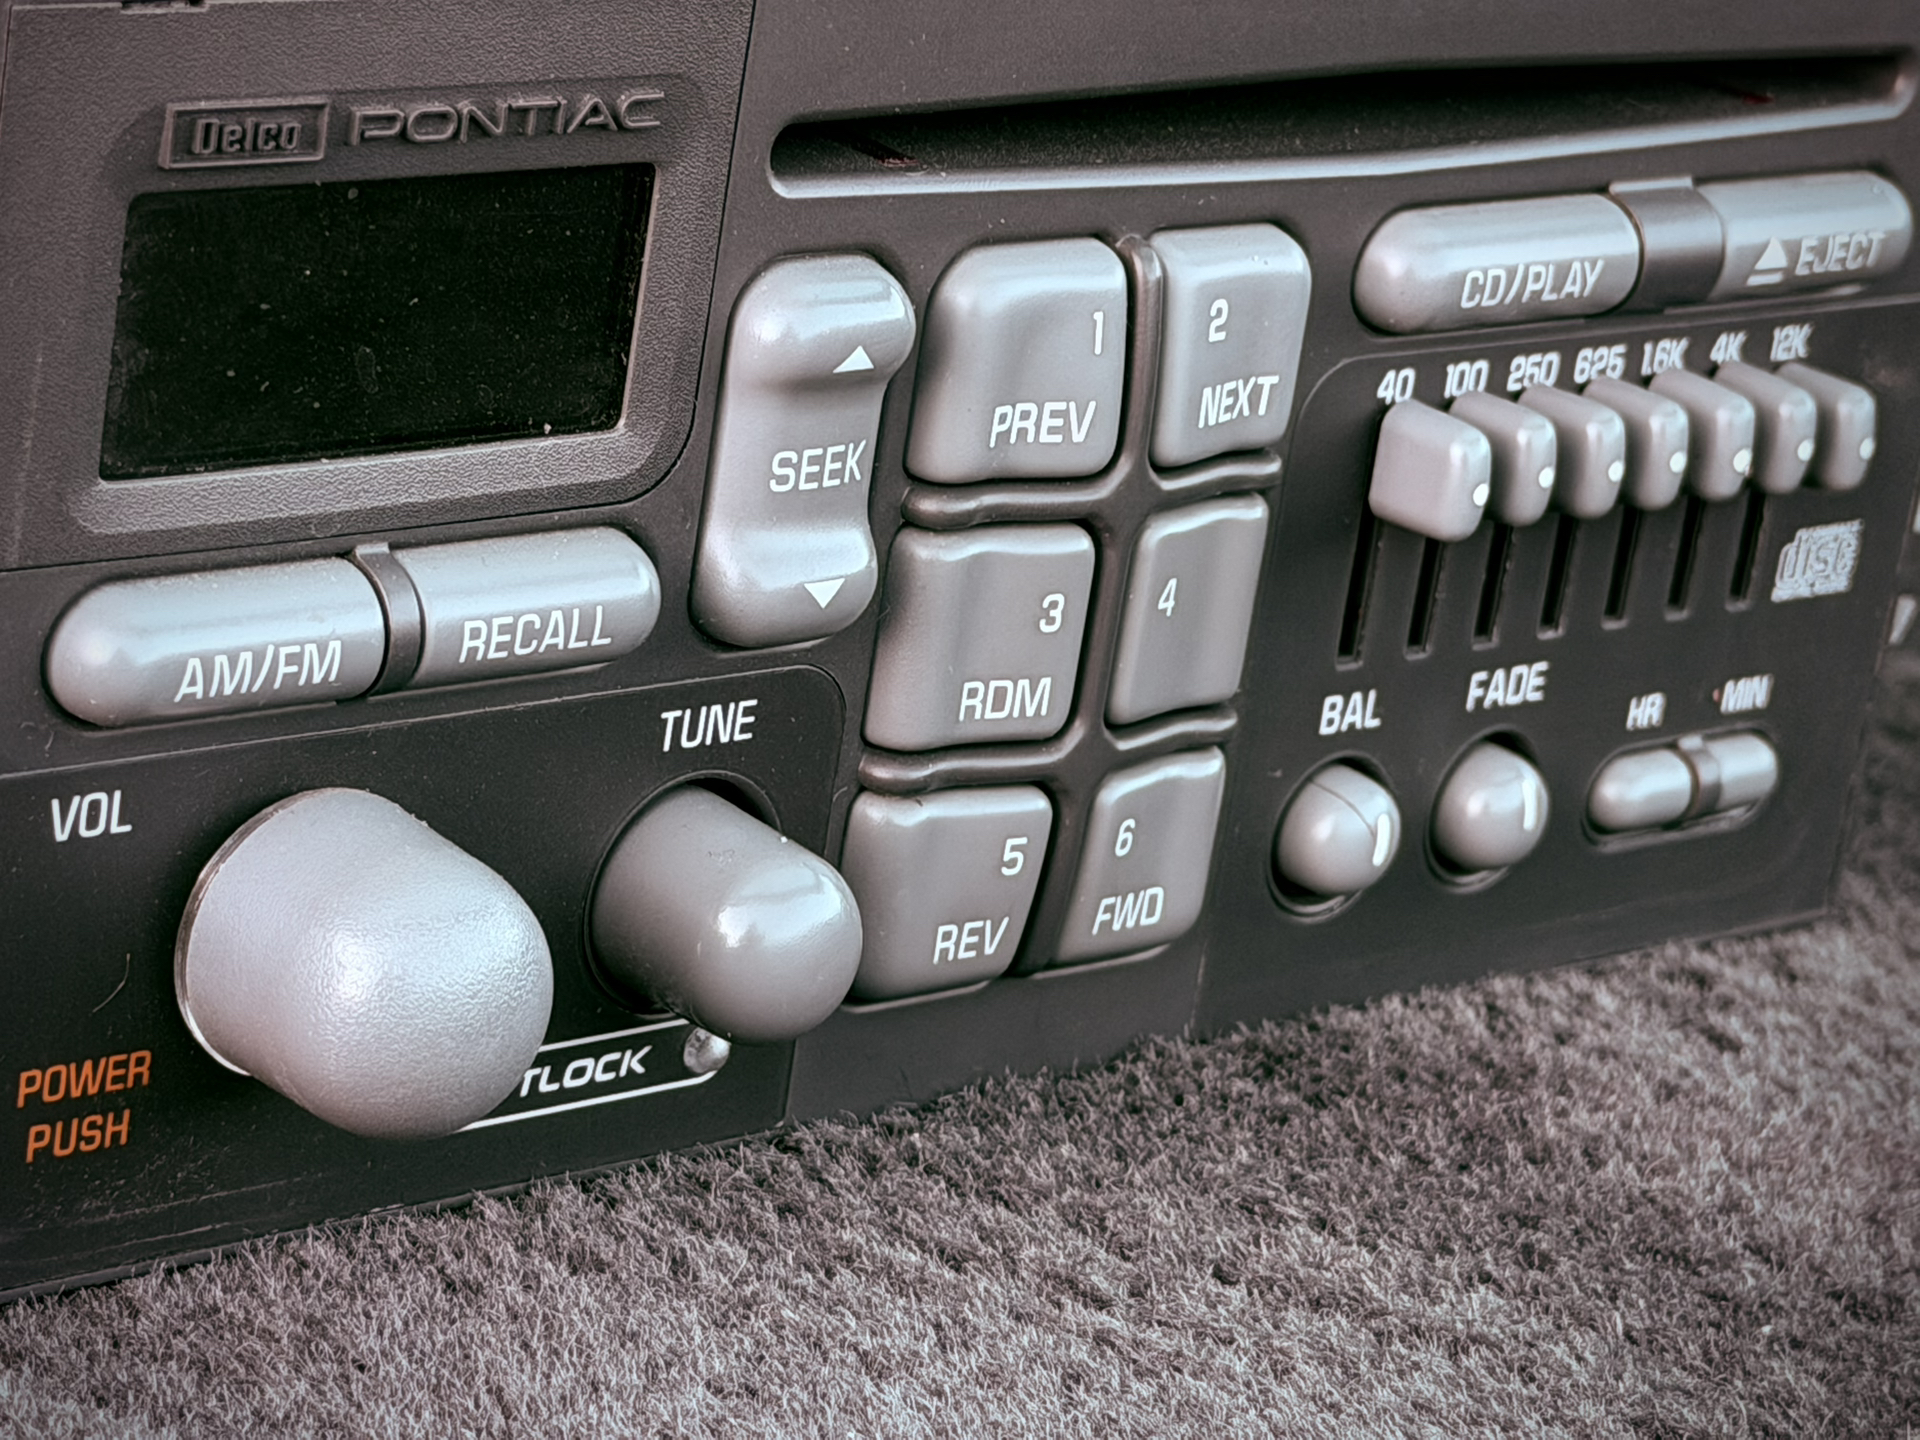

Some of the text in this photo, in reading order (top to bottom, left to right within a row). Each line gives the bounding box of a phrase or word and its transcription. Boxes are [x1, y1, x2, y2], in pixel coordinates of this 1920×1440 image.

[192, 117, 302, 155] Delco
[349, 89, 665, 146] PONTIAC
[1794, 231, 1887, 277] EJECT
[1460, 257, 1605, 310] CD/PLAY
[1091, 310, 1105, 356] 1
[1207, 297, 1229, 343] 2
[1376, 366, 1416, 405] 40
[1444, 358, 1490, 399] 100
[1506, 350, 1562, 392] 250
[1573, 343, 1628, 385] 625
[1709, 328, 1749, 364] 4K
[1769, 321, 1815, 362] 12K
[988, 399, 1097, 449] PREV
[1197, 374, 1280, 430] NEXT
[769, 440, 867, 493] SEEK
[1038, 592, 1066, 634] 3
[1157, 577, 1179, 617] 4
[458, 604, 613, 663] RECALL
[174, 639, 344, 702] AM/FM
[1465, 660, 1551, 713] FADE
[660, 698, 759, 752] TUNE
[957, 676, 1053, 722] RDM
[1318, 689, 1382, 736] BAL
[1625, 673, 1775, 732] HR MIN
[50, 789, 133, 843] VOL
[1114, 817, 1137, 858] 6
[1000, 836, 1029, 876] 5
[1092, 885, 1166, 936] FWD
[932, 915, 1010, 966] REV
[16, 1049, 153, 1109] POWER
[25, 1109, 132, 1163] PUSH
